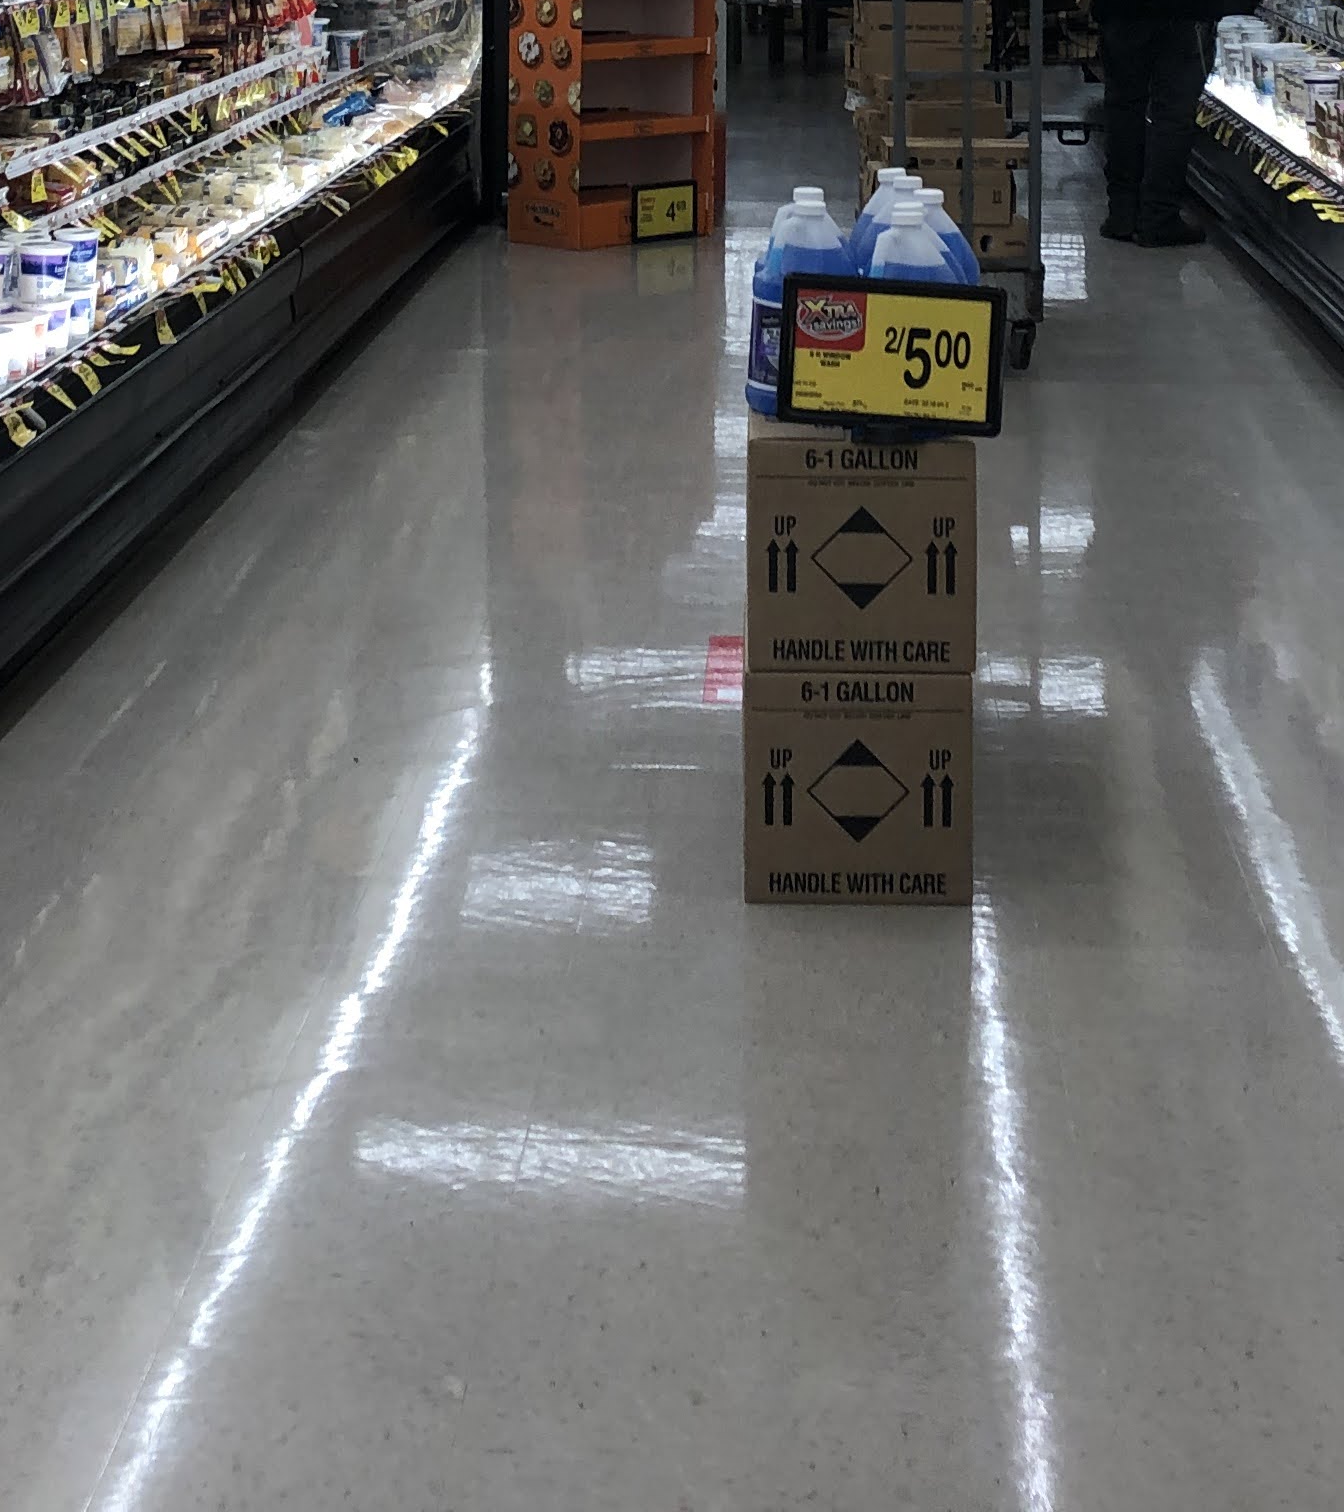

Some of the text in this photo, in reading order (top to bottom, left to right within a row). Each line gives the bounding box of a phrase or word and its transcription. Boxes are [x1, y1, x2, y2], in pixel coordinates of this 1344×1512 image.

[805, 448, 919, 471] 6-1 GALLON
[774, 515, 797, 536] UP
[932, 516, 956, 538] UP
[772, 639, 951, 664] HANDLE WITH CARE
[800, 681, 915, 704] 6-1 GALLON
[769, 748, 793, 770] UP
[929, 749, 952, 770] UP
[768, 872, 948, 896] HANDLE WITH CARE
